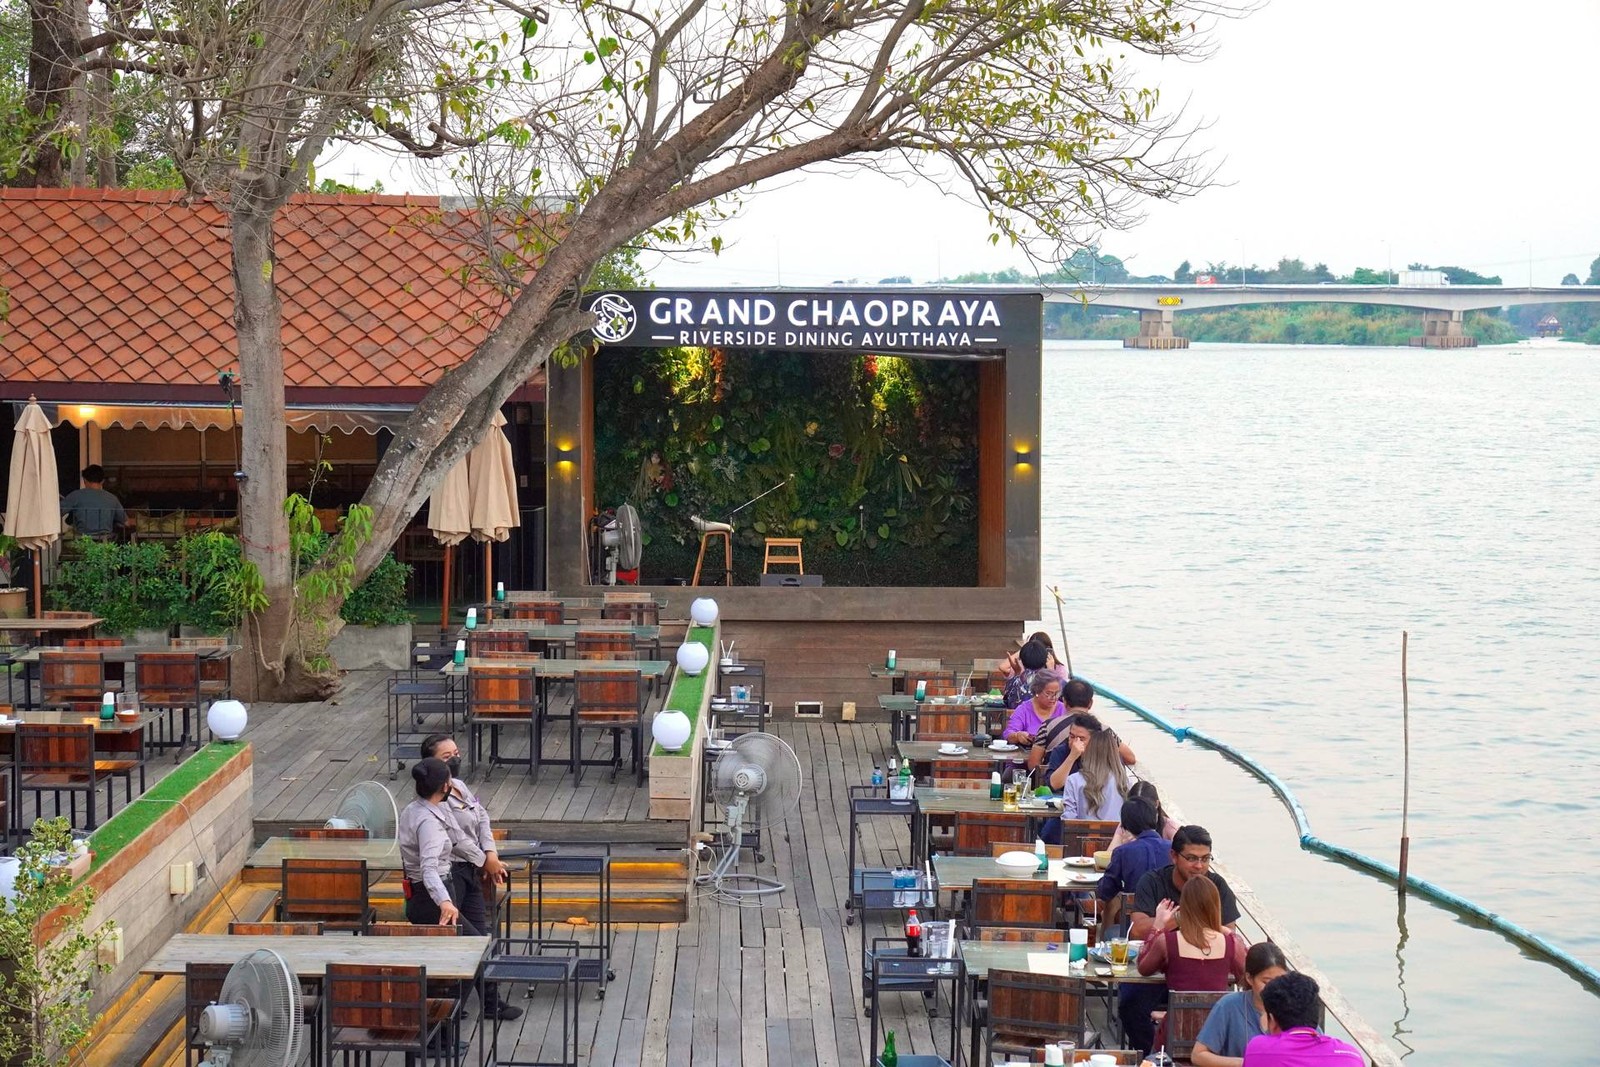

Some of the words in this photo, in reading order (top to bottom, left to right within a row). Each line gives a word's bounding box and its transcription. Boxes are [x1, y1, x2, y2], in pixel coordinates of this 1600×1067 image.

[649, 297, 776, 326] GRAND
[787, 298, 1001, 327] CHAOPRAYA
[679, 330, 777, 346] RIVERSIDE
[785, 331, 853, 347] DINING
[861, 331, 972, 347] AYUTTHAYA
